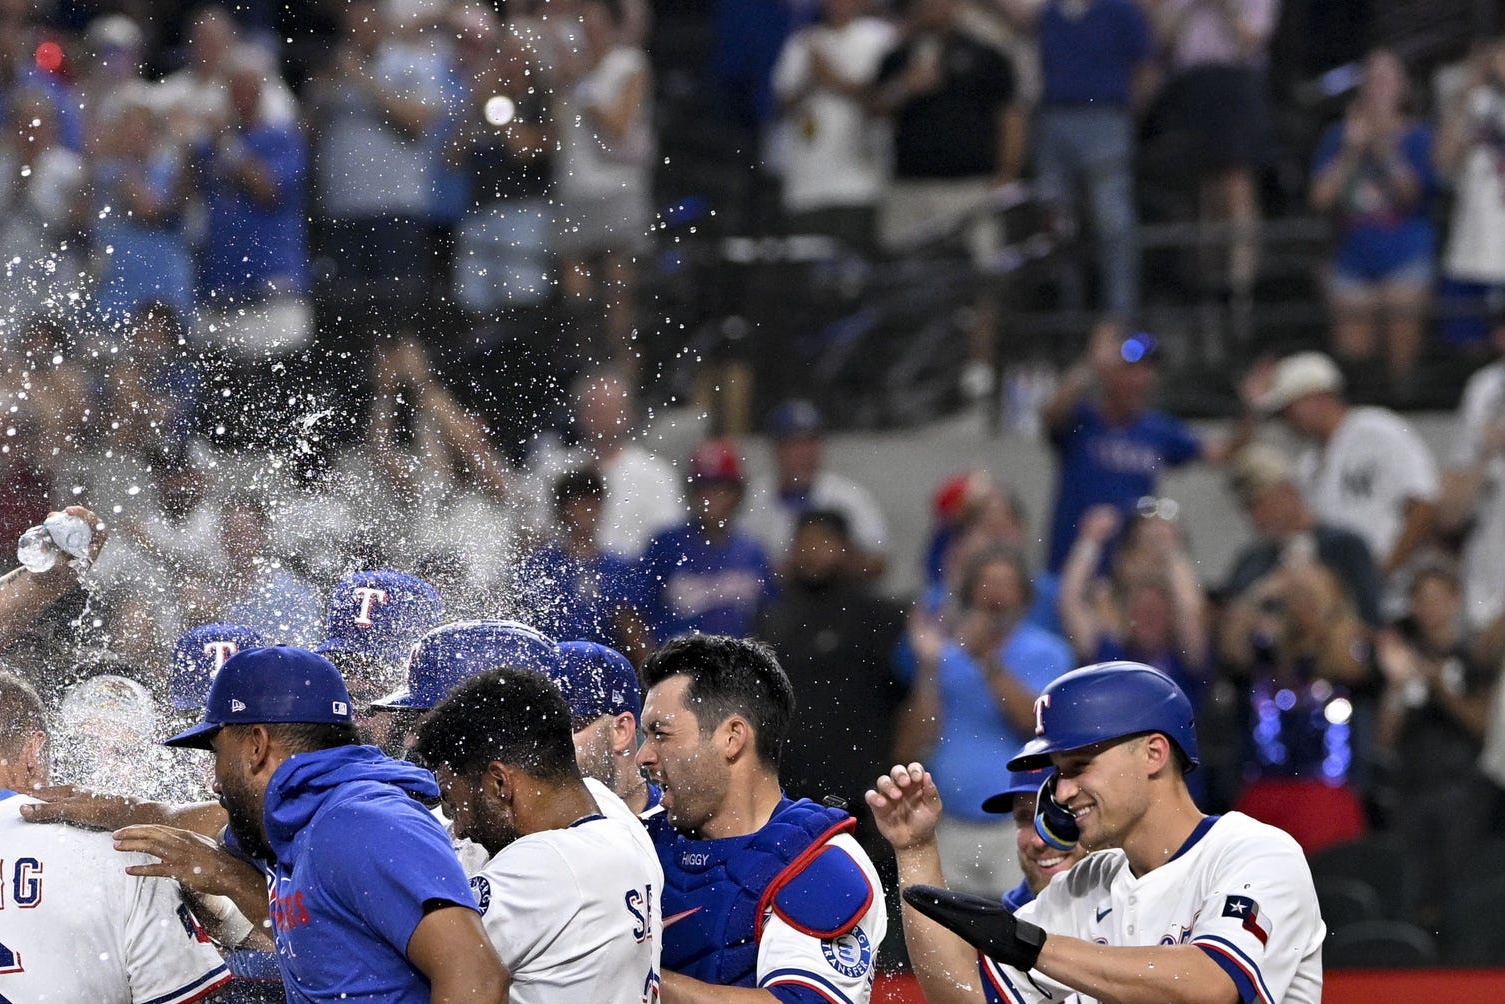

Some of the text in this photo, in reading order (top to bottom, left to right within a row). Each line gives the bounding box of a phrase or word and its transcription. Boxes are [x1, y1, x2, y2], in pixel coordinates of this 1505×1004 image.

[354, 586, 388, 627] T
[681, 853, 710, 866] HIGGY
[822, 943, 869, 977] TRANSFER
